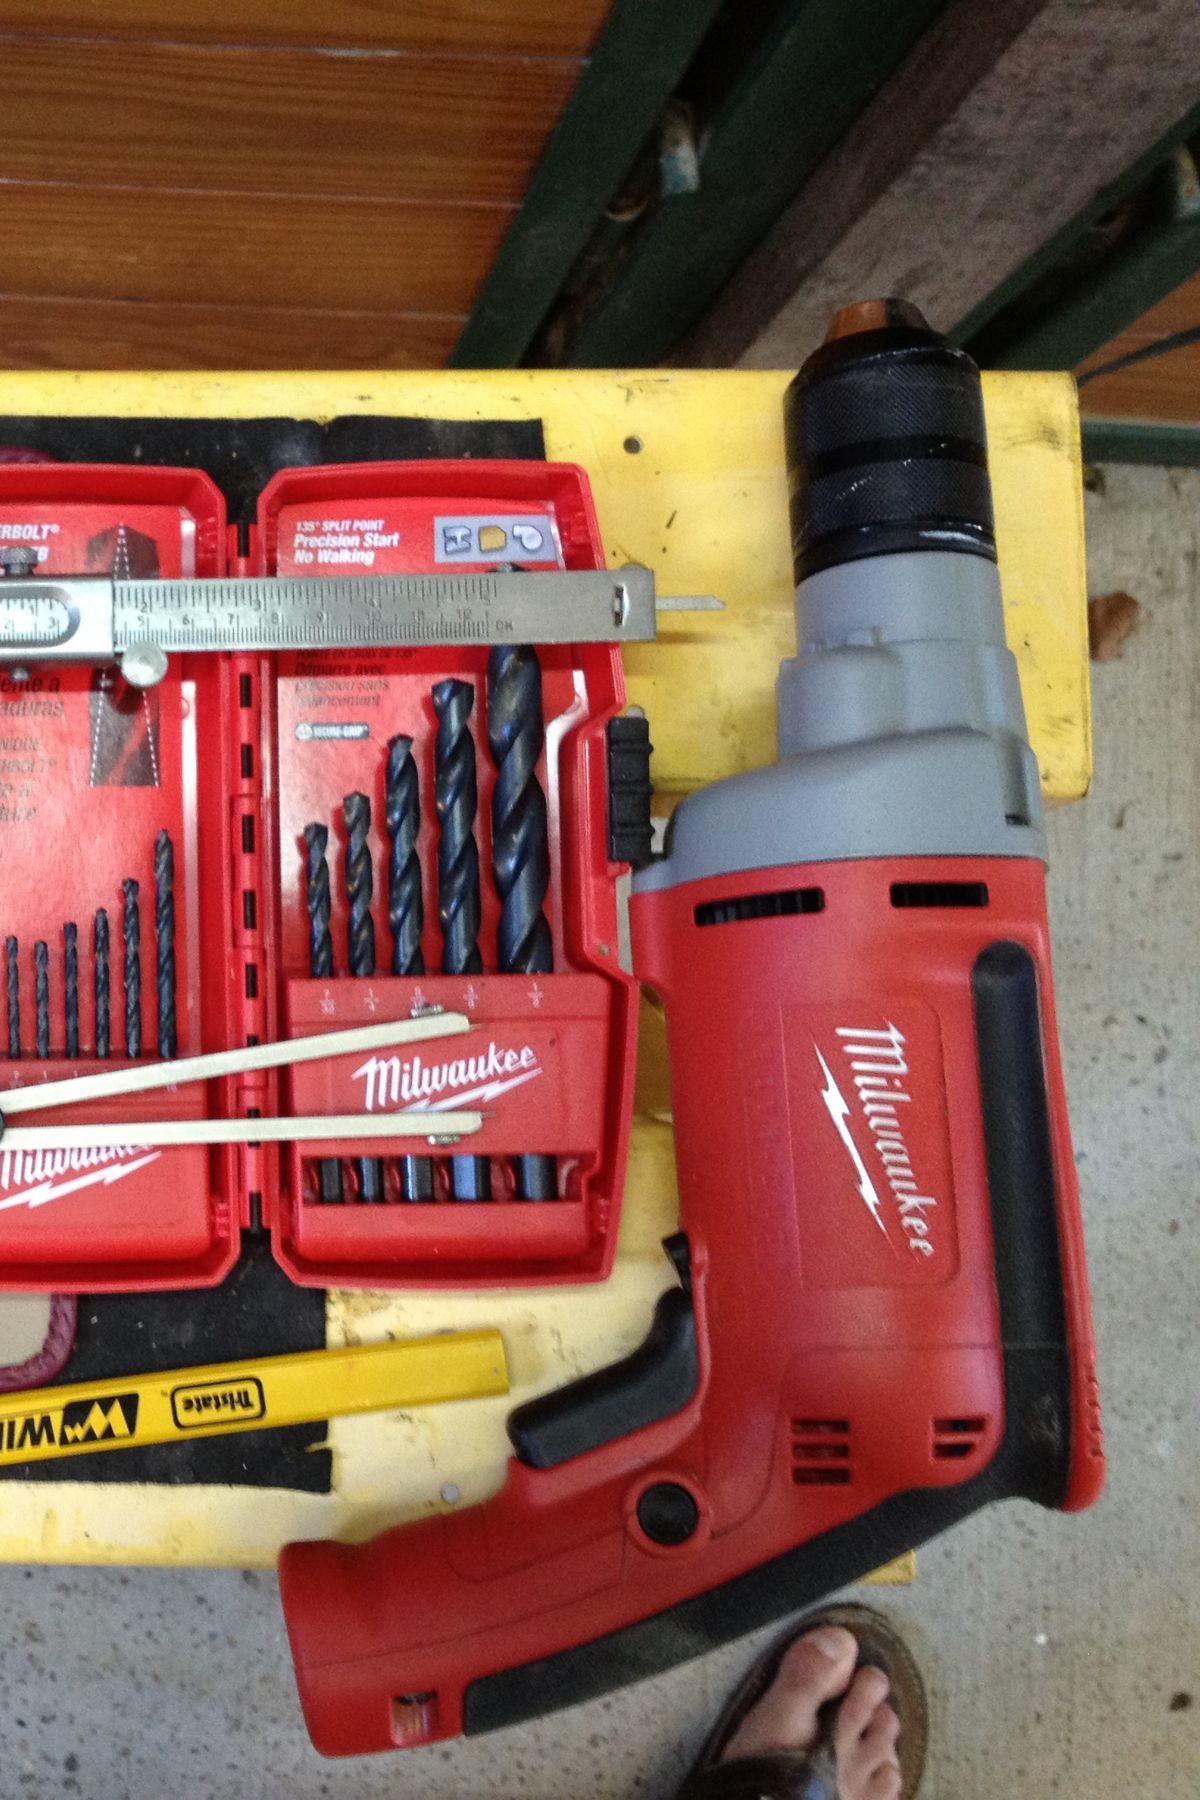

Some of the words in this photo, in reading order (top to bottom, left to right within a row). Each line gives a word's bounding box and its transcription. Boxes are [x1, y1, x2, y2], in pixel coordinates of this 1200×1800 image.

[321, 519, 352, 532] SPLIT
[352, 519, 385, 532] POINT
[293, 532, 360, 549] Precision
[362, 531, 400, 547] Start
[293, 548, 314, 564] No
[317, 548, 375, 567] Walking
[352, 1041, 538, 1112] Milwaukee
[834, 1015, 938, 1260] Milwaukee
[182, 1388, 255, 1414] Tristate
